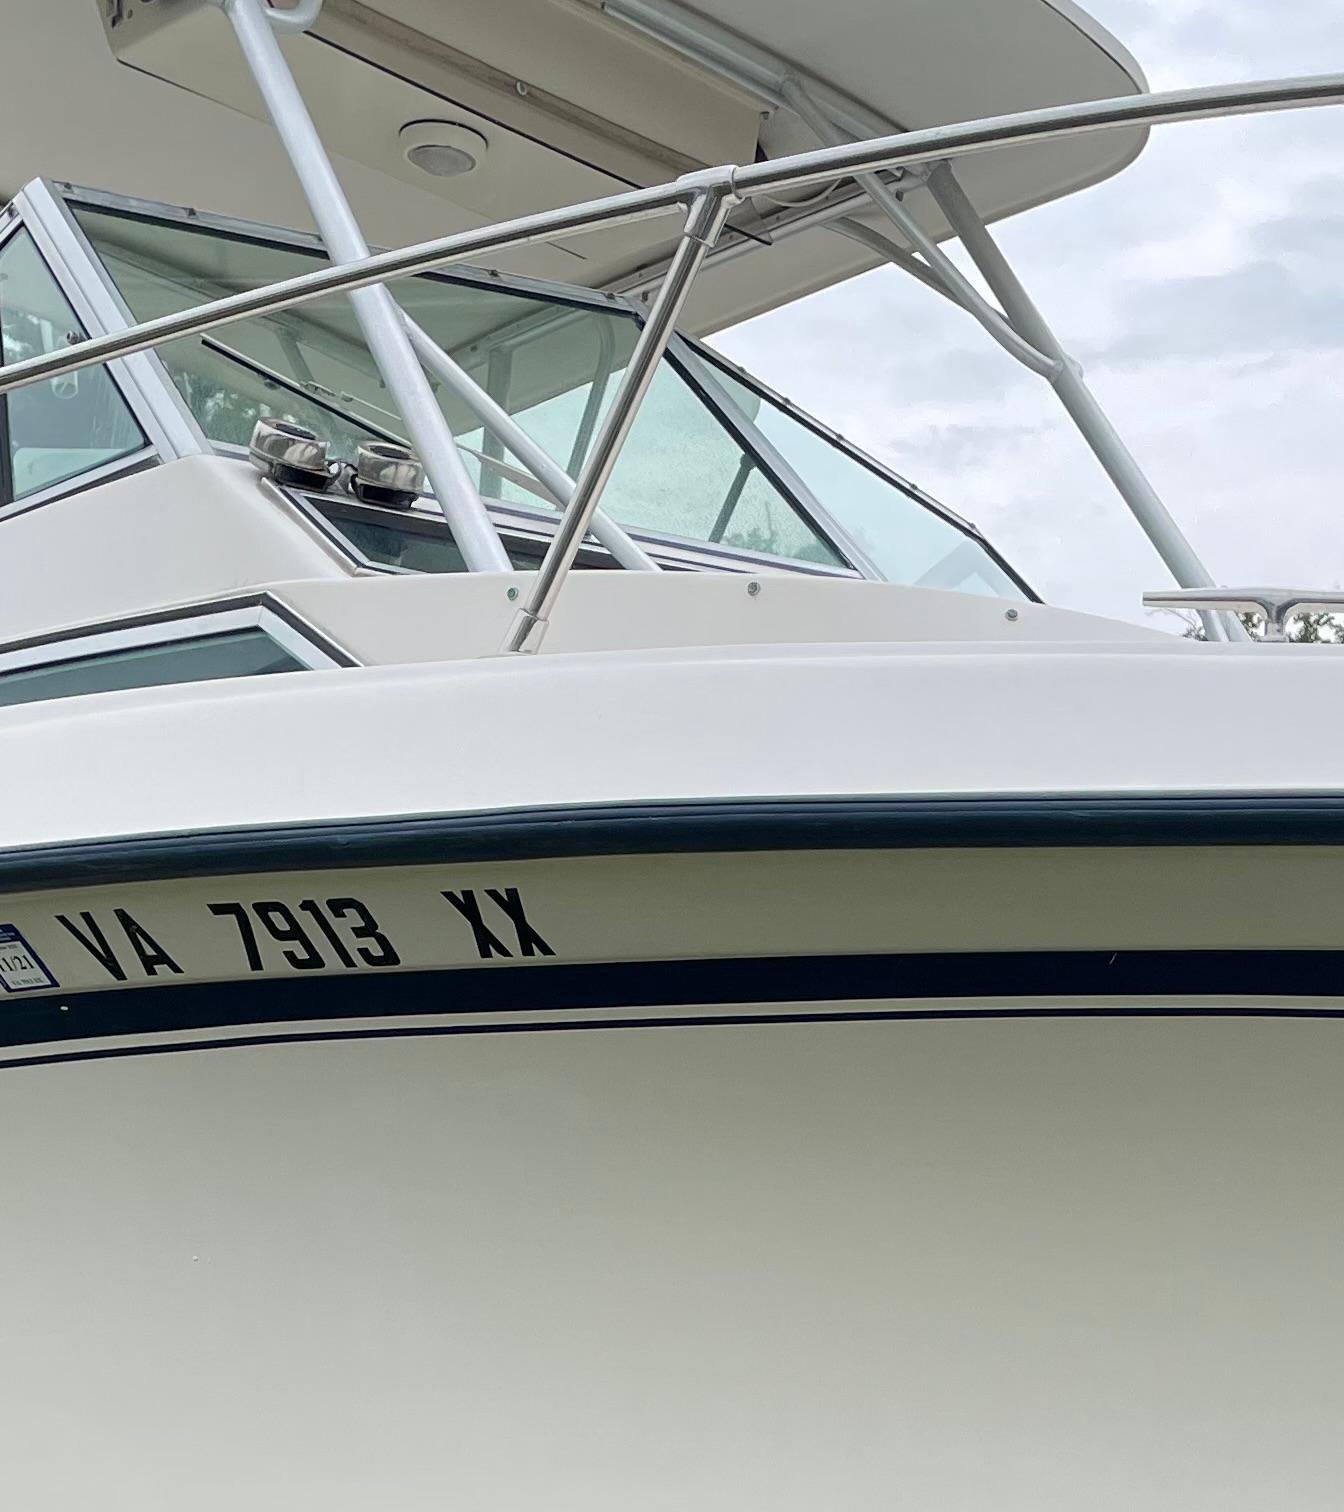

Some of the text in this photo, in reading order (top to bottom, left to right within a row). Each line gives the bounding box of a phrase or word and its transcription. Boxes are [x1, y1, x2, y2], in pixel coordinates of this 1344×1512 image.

[55, 887, 556, 981] VA 7913 XX
